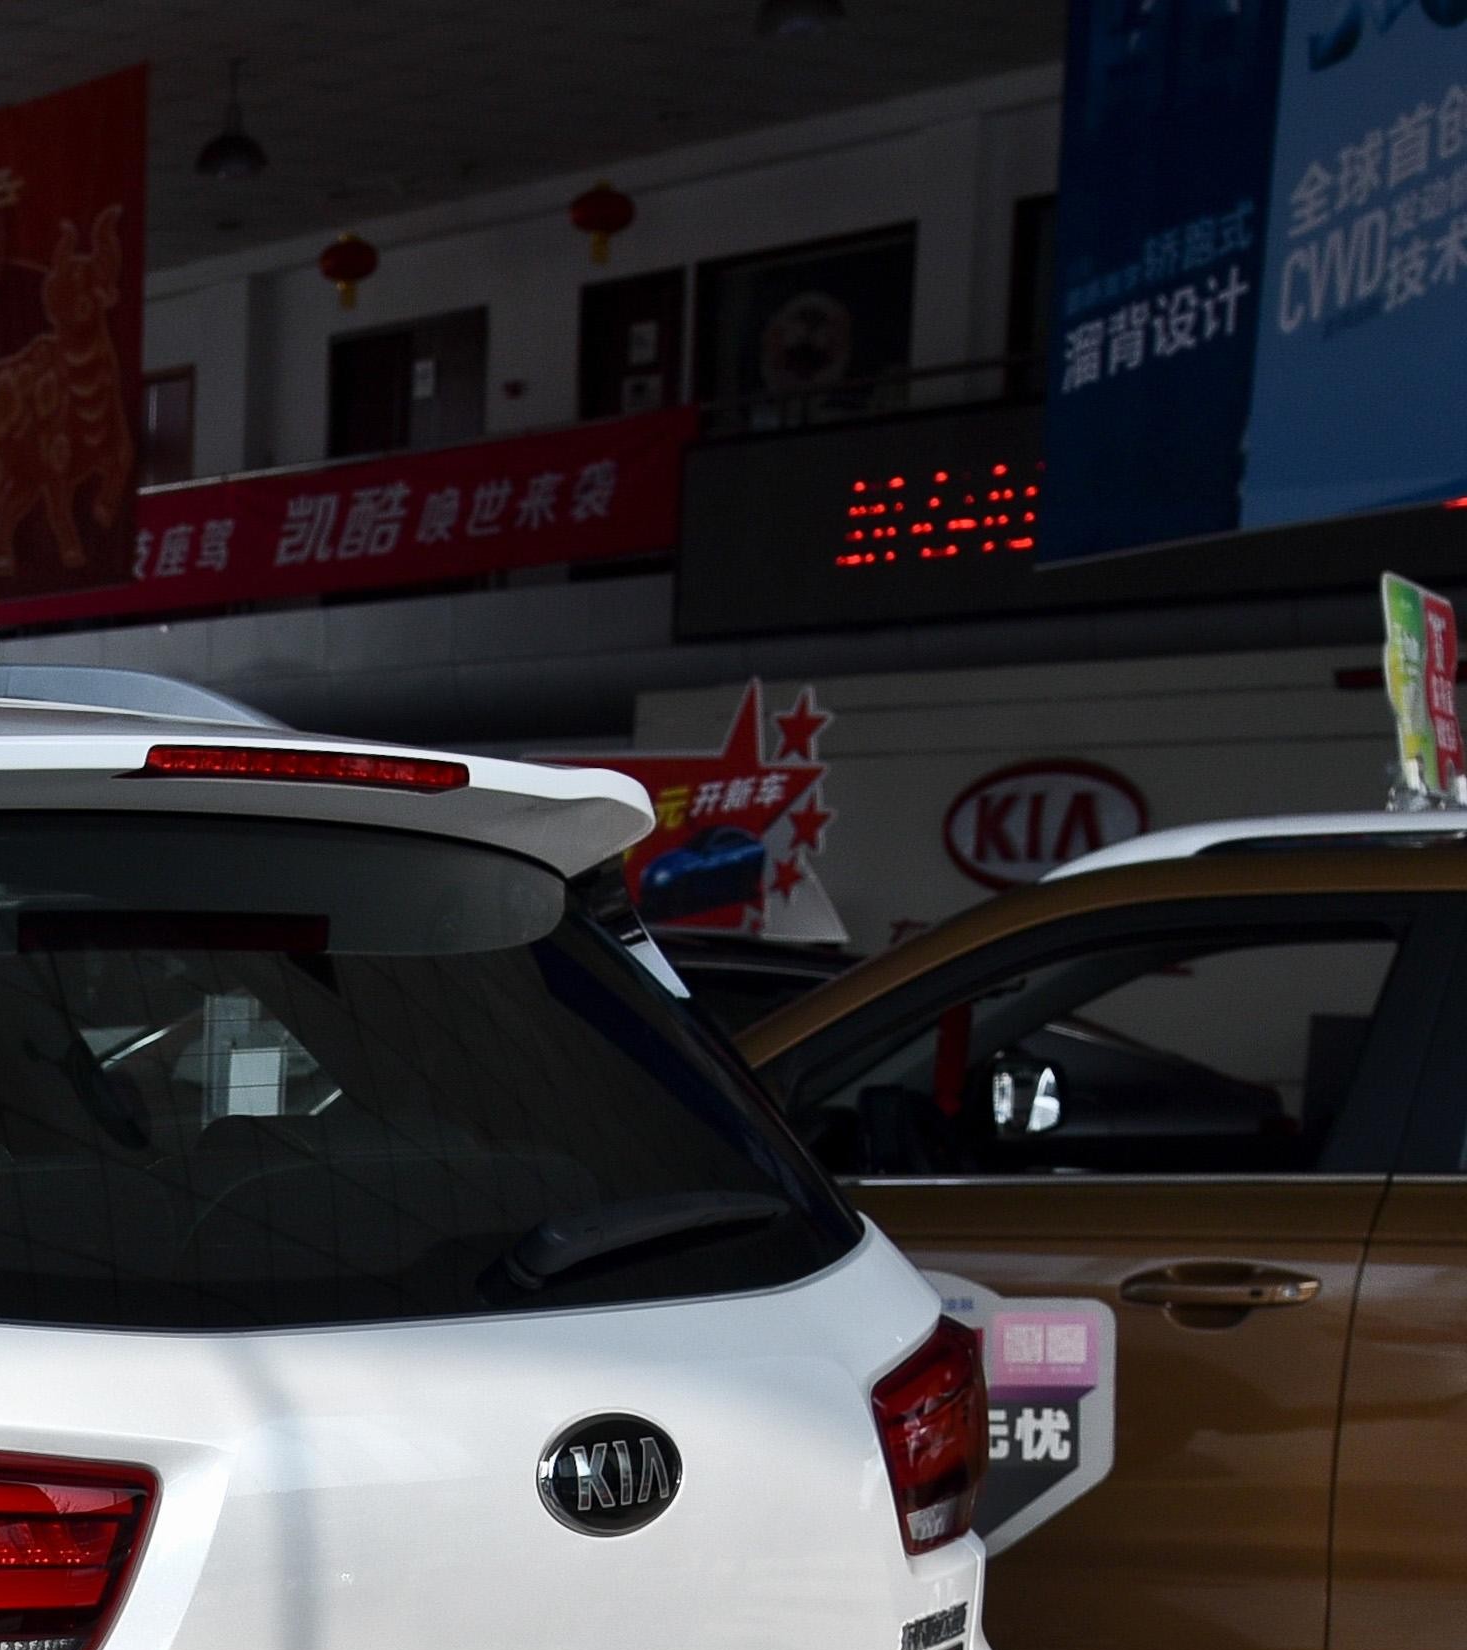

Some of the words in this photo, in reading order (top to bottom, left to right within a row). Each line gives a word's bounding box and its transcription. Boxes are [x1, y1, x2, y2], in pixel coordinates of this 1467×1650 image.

[1060, 265, 1251, 395] 溜背设计
[973, 790, 1102, 862] KIA
[569, 1437, 670, 1511] KIA
